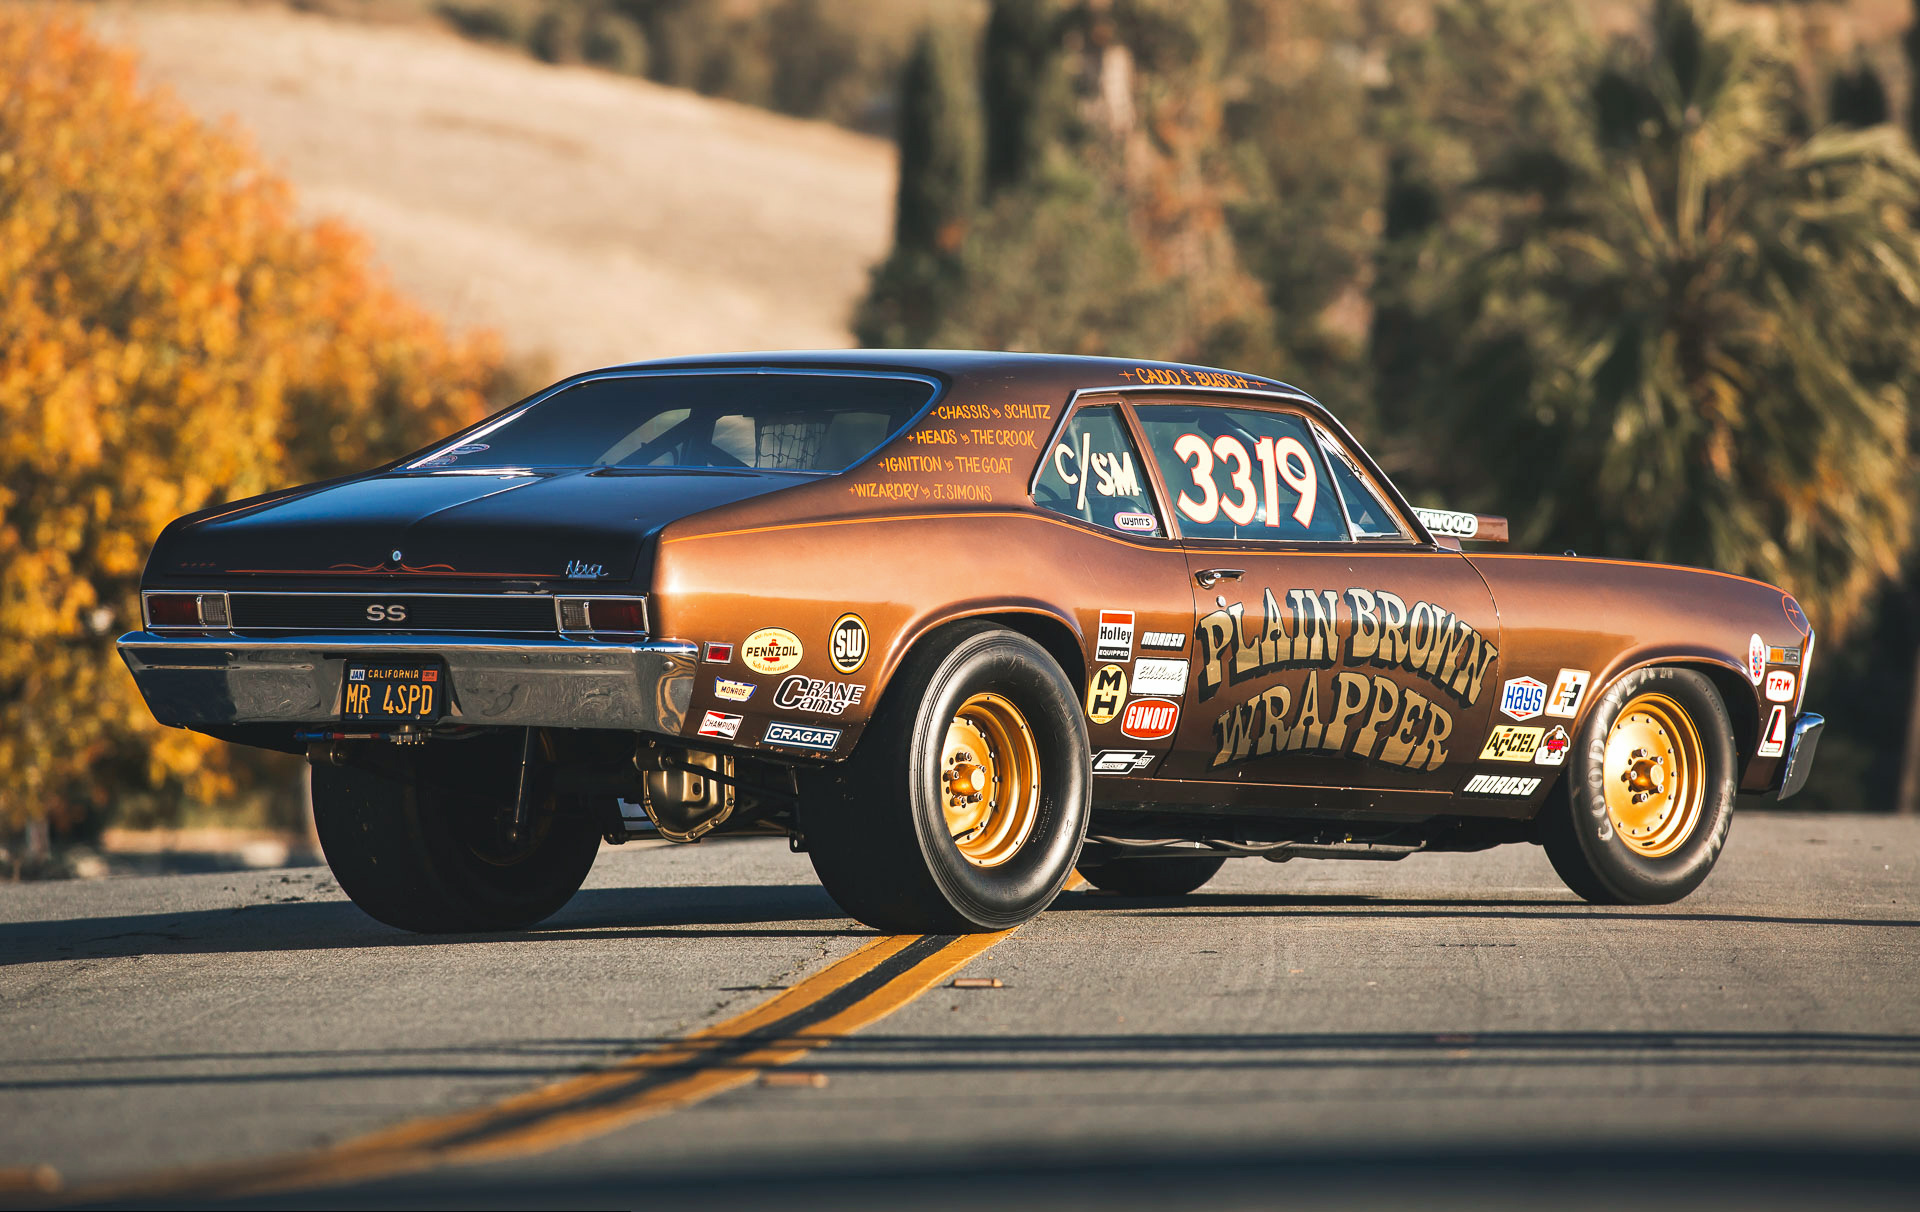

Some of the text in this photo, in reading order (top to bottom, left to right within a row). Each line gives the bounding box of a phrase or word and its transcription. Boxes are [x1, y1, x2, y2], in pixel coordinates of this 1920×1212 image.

[1135, 367, 1181, 385] CADO
[1193, 371, 1249, 389] BUSCH
[937, 404, 991, 420] CHASSIS
[1003, 404, 1051, 420] SCHLITZ
[916, 429, 958, 445] HEADS
[971, 429, 995, 445] THE
[995, 430, 1039, 450] CROOK
[885, 456, 943, 473] IGNITION
[955, 456, 981, 474] THE
[981, 457, 1013, 474] GOAT
[1054, 432, 1140, 510] C/SM
[1173, 433, 1317, 529] 3319
[854, 482, 920, 501] WIZARDRY
[946, 483, 993, 503] SIMONS
[565, 560, 609, 576] Nova
[366, 604, 406, 622] SS
[835, 628, 863, 658] SW
[1100, 626, 1132, 644] Holley
[746, 645, 798, 657] PENNZOIL
[1196, 587, 1340, 700] PLAIN
[1344, 587, 1499, 706] BROWN
[351, 671, 364, 679] JAN
[368, 669, 419, 679] CALIFORNIA
[720, 686, 746, 697] MONROE
[1769, 678, 1792, 691] TRW
[345, 683, 433, 715] MR 4SPD
[1505, 685, 1543, 712] Hays
[704, 718, 737, 731] CHAMPION
[1126, 706, 1175, 730] GUMOUT
[1210, 668, 1454, 773] WRAPPER
[770, 727, 834, 745] CRAGAR
